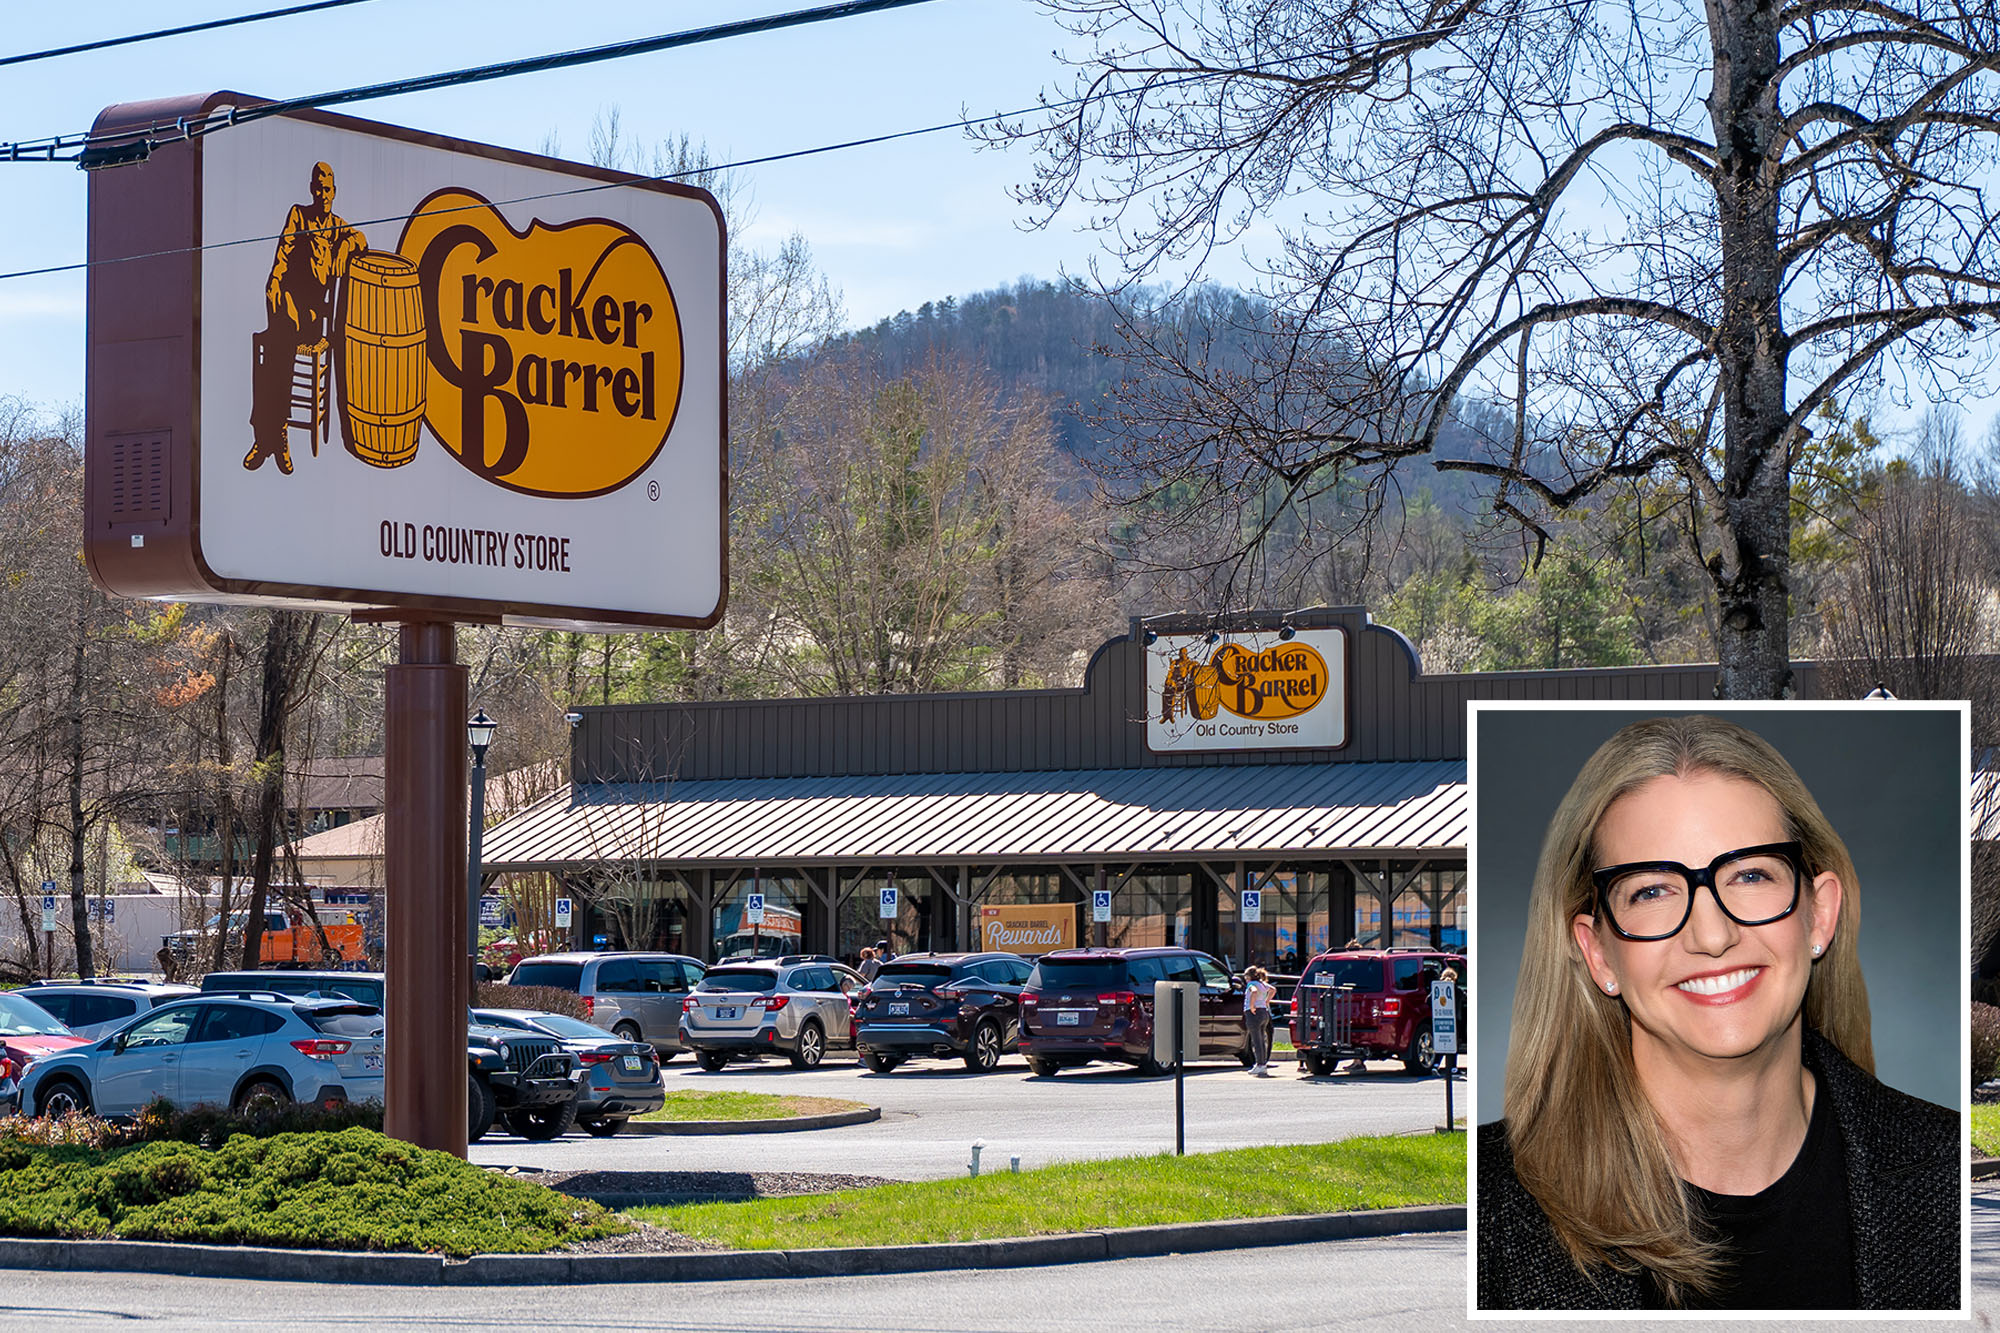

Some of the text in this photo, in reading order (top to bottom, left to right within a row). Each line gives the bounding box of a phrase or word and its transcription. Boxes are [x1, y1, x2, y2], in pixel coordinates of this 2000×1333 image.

[420, 224, 653, 388] Cracker
[459, 329, 657, 477] Barrel
[380, 520, 571, 573] OLD COUNTRY STORE
[1214, 646, 1308, 685] Cracker
[1236, 673, 1317, 715] Barrel
[1196, 722, 1299, 737] Old Country Store
[987, 918, 1068, 950] Rewards!
[1006, 920, 1049, 928] CRACKER BARREL
